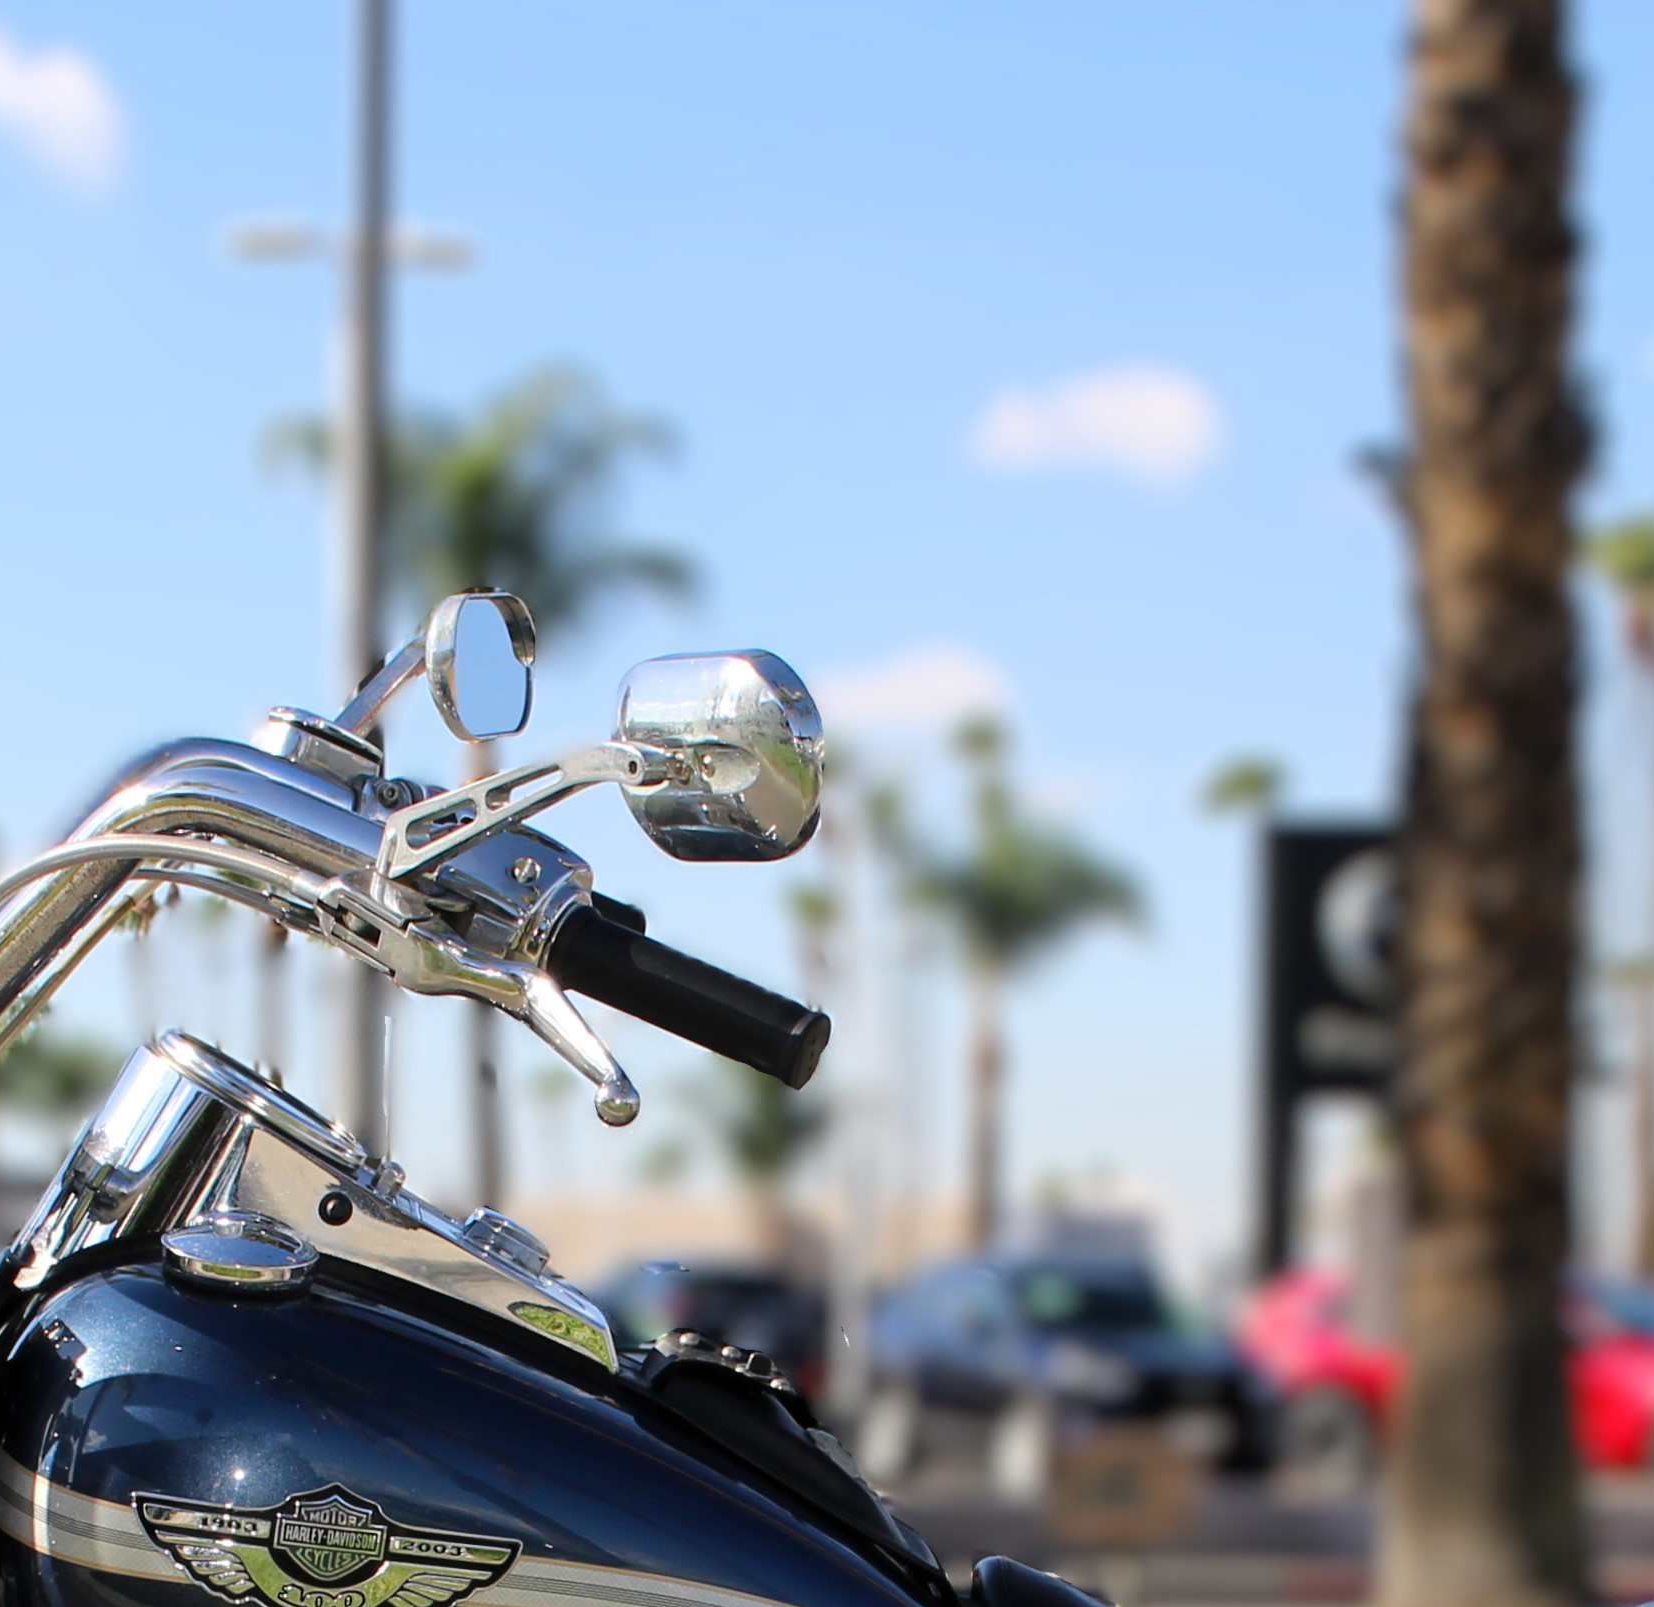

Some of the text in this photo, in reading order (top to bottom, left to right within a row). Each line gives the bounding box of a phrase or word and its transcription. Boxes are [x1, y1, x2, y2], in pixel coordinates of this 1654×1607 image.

[199, 1515, 256, 1534] 1903
[309, 1507, 359, 1527] MOTOR
[285, 1524, 377, 1550] HARLEY-DAVIDSON
[402, 1540, 464, 1557] 2003
[304, 1548, 353, 1571] CYCLES
